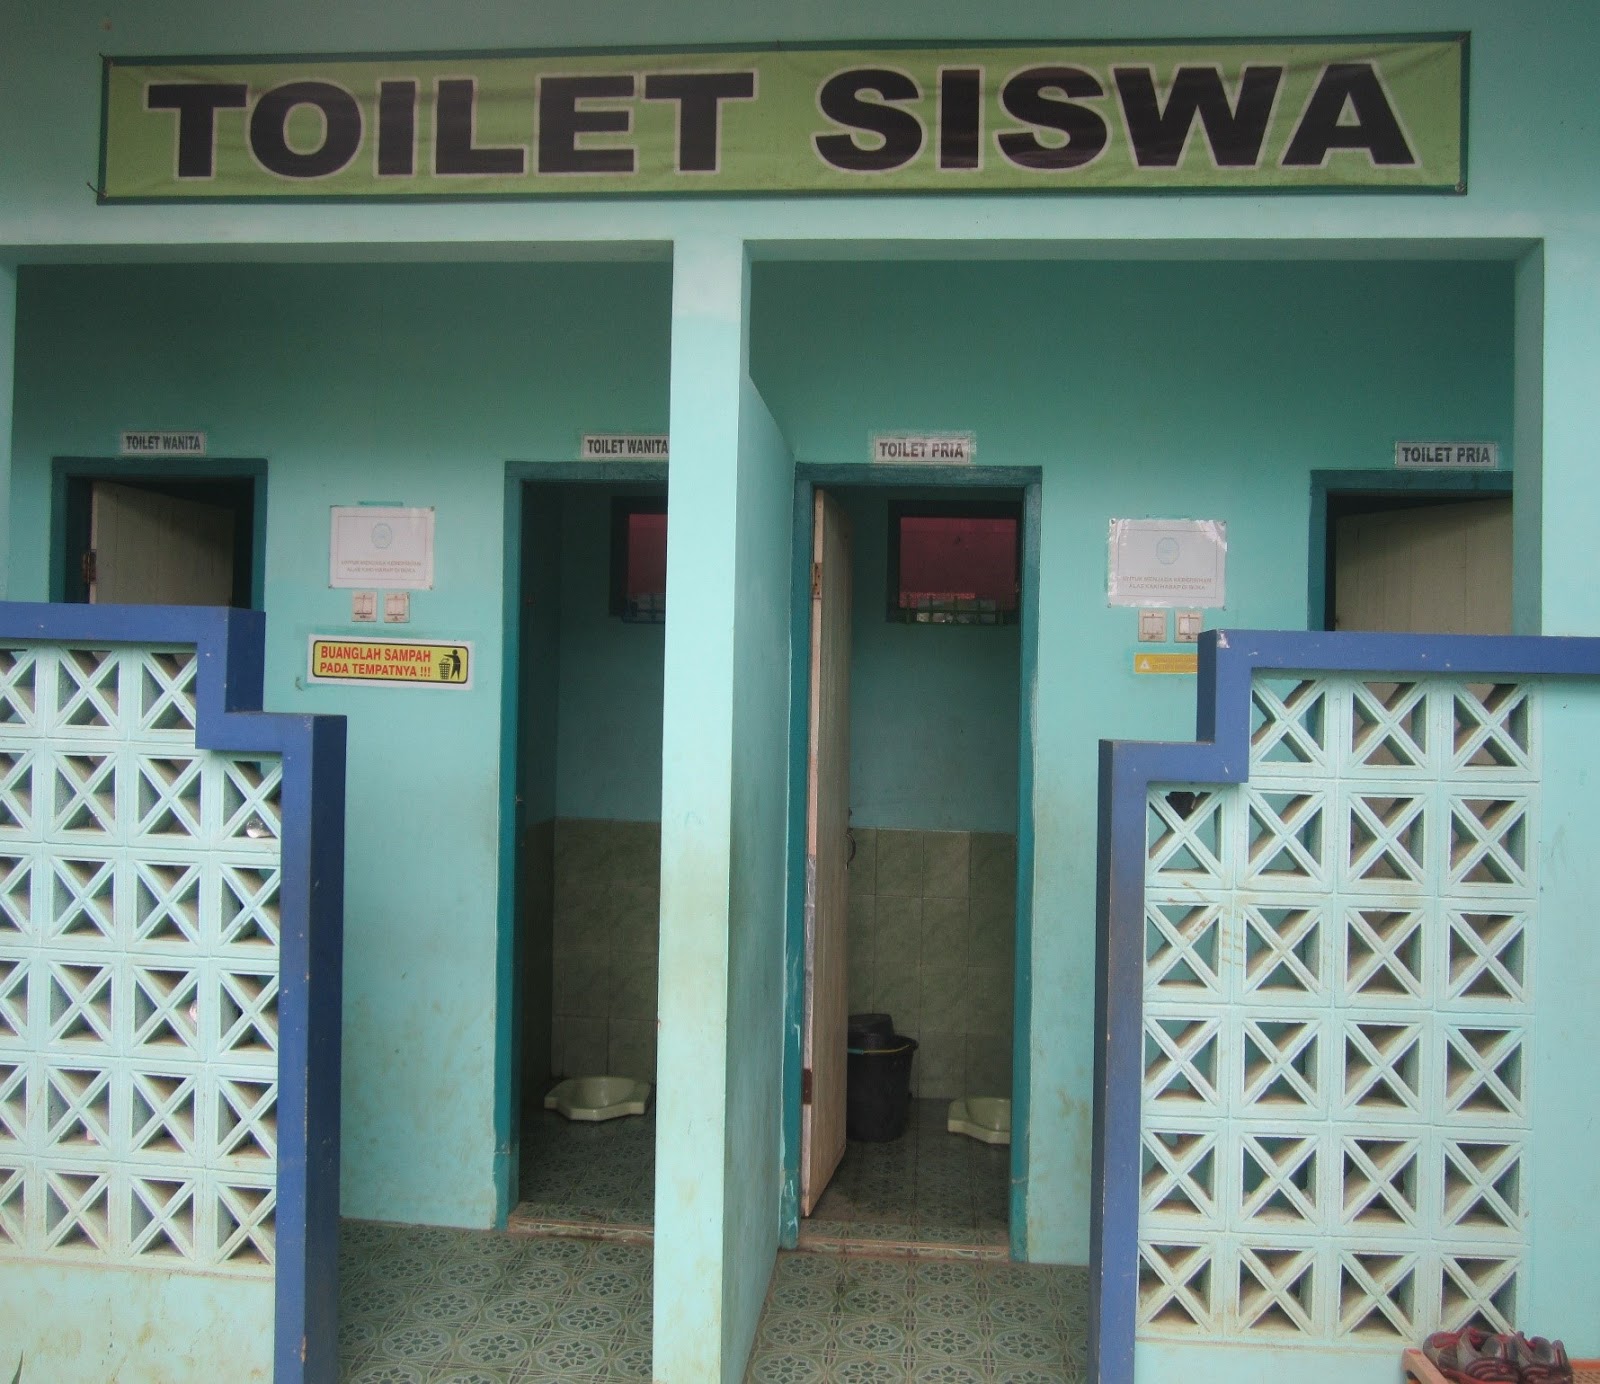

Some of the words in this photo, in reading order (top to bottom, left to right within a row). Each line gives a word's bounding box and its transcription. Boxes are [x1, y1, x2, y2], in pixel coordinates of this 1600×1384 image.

[146, 71, 756, 179] TOILET
[812, 64, 1416, 171] SISWA
[126, 435, 160, 449] TOILET
[163, 435, 200, 449] WANITA
[587, 439, 624, 454] TOILET
[627, 439, 669, 454] WANITA
[879, 442, 928, 458] TOILET
[931, 442, 964, 458] PRIA
[1402, 447, 1452, 462] TOILET
[1457, 447, 1490, 462] PRIA
[320, 645, 381, 661] BUANGLAH
[384, 648, 431, 663] SAMPAH
[319, 662, 349, 674] PADA
[352, 663, 417, 677] TEMPATNYA
[420, 666, 431, 678] !!!
